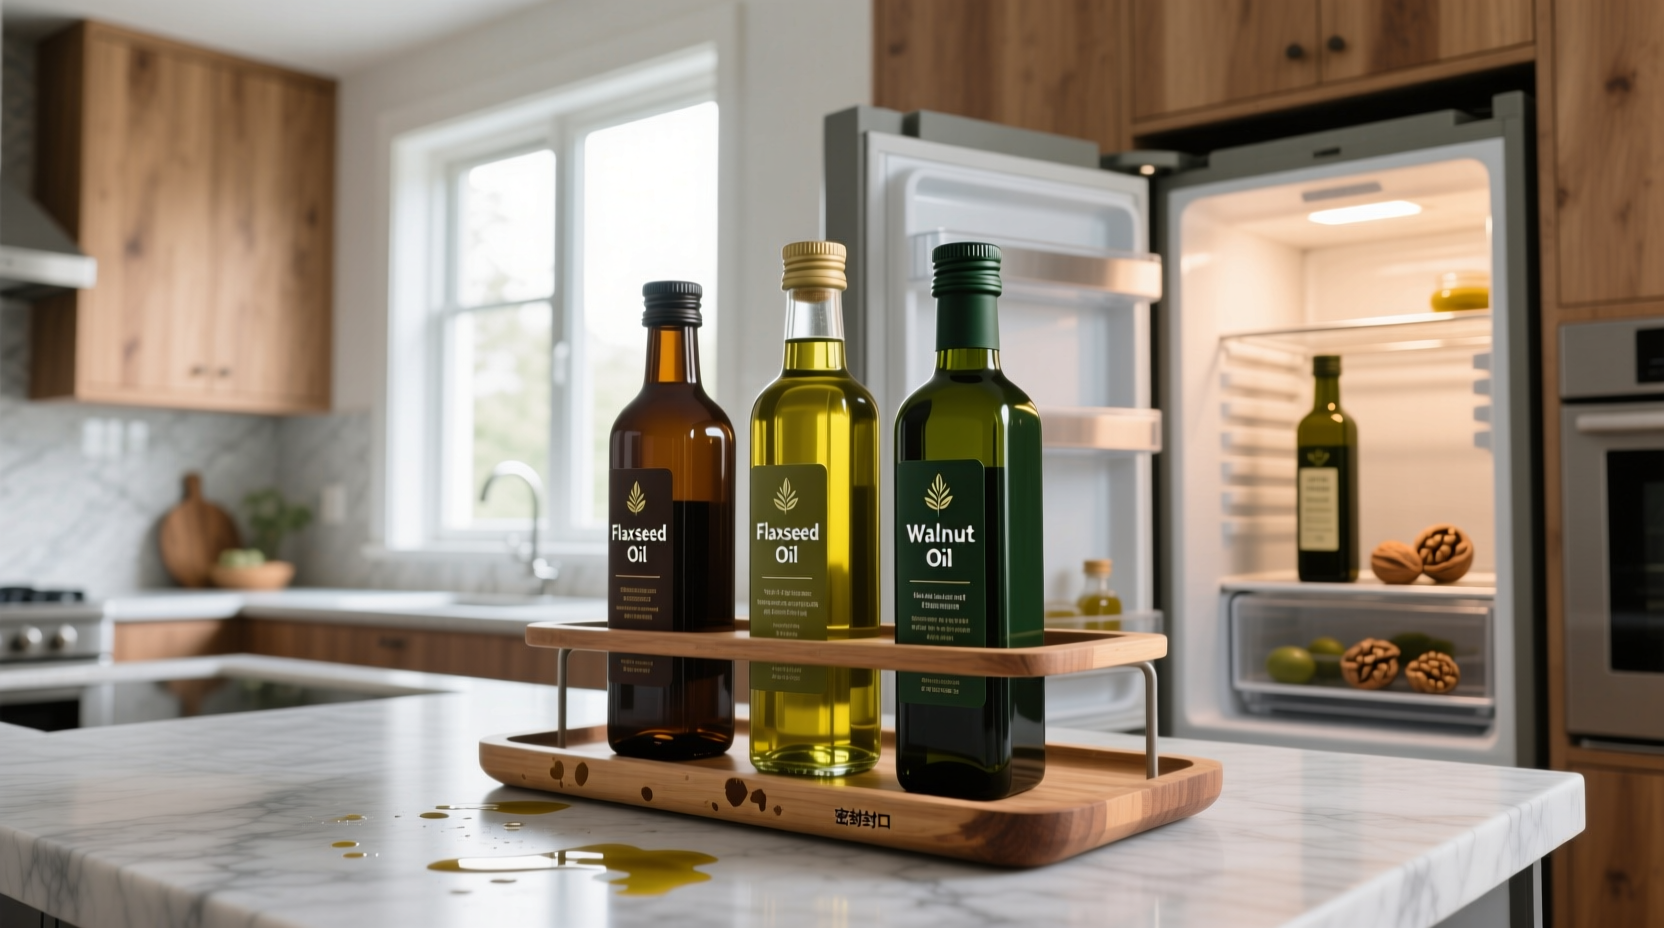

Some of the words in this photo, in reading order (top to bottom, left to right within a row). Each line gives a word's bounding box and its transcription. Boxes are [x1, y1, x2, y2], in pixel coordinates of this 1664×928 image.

[612, 523, 667, 542] Flaxseed
[756, 522, 819, 541] Flaxseed
[906, 522, 976, 544] Walnut
[627, 545, 647, 563] Oil
[775, 546, 798, 564] Oil
[926, 548, 953, 568] Oil
